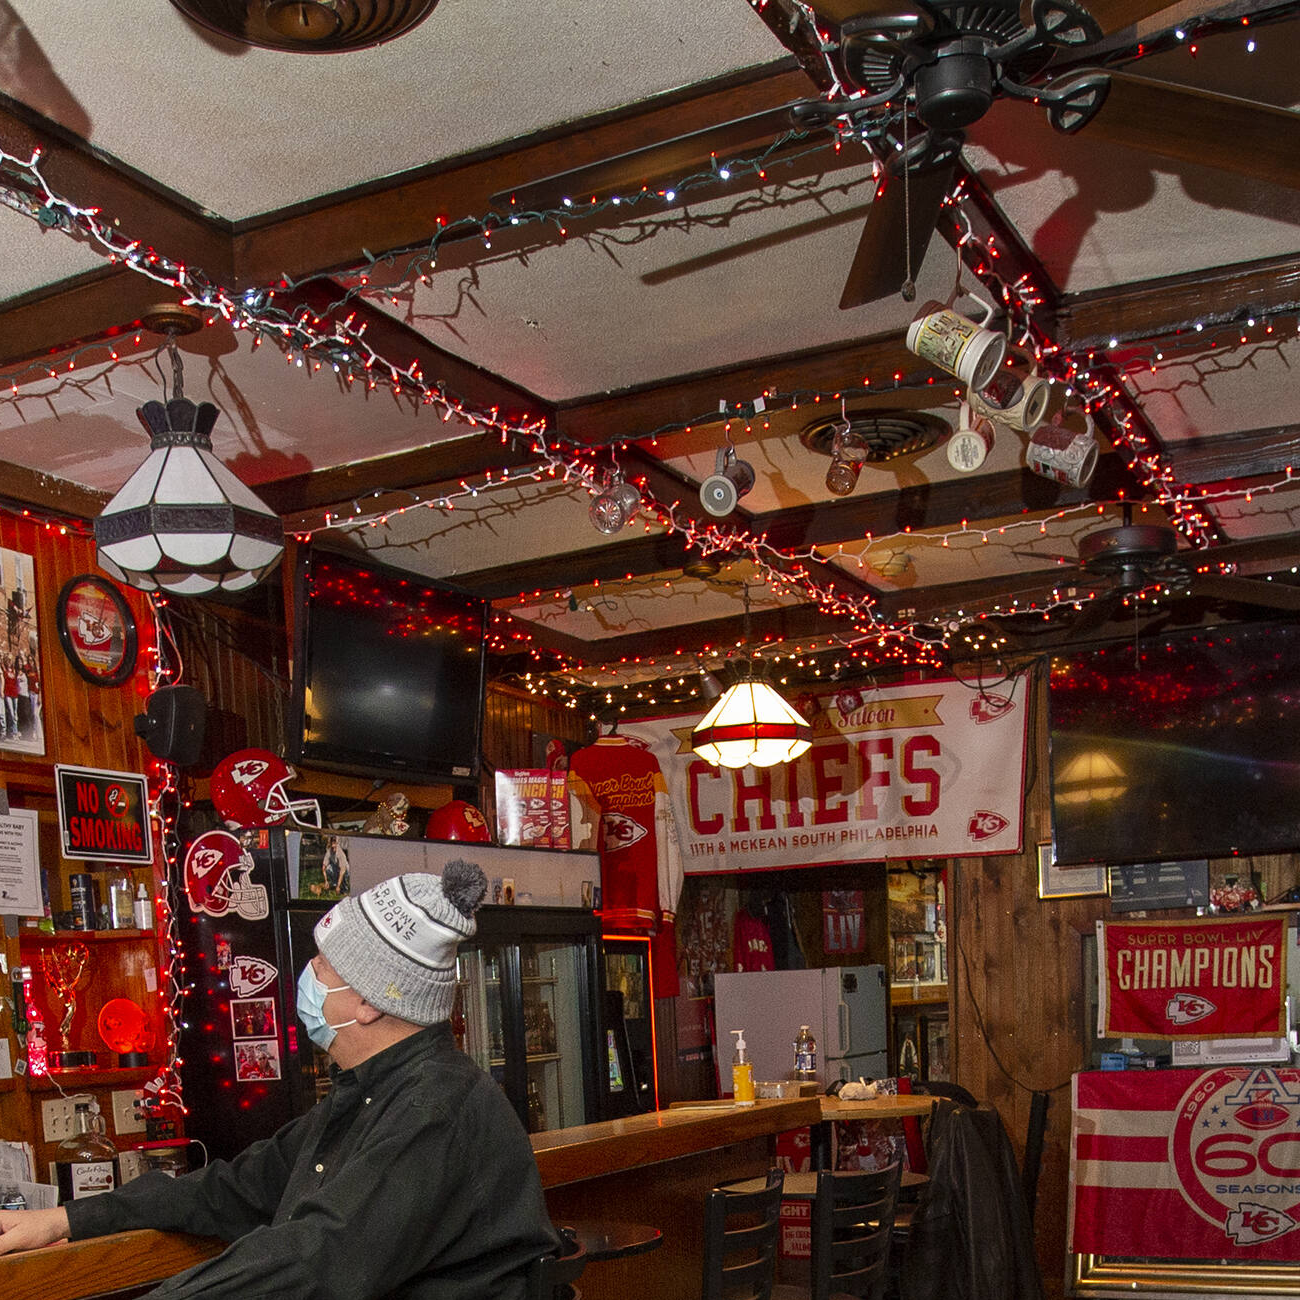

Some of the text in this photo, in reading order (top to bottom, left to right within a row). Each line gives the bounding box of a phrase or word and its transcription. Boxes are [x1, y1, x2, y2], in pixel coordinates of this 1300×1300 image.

[76, 781, 99, 815] NO
[620, 771, 655, 792] Bowl
[686, 733, 942, 835] CHIEFS
[70, 816, 143, 851] SMOKING
[690, 823, 939, 858] 11TH & MCKEAN SOUTH PHILADELPHIA
[387, 899, 417, 934] BOWL
[827, 914, 861, 950] LIV
[1127, 929, 1264, 946] SUPER BOWL LIV
[240, 963, 266, 986] KC
[1116, 944, 1275, 991] CHAMPIONS
[1178, 999, 1205, 1018] KC
[1183, 1080, 1216, 1121] 1960
[1241, 1211, 1280, 1235] KC
